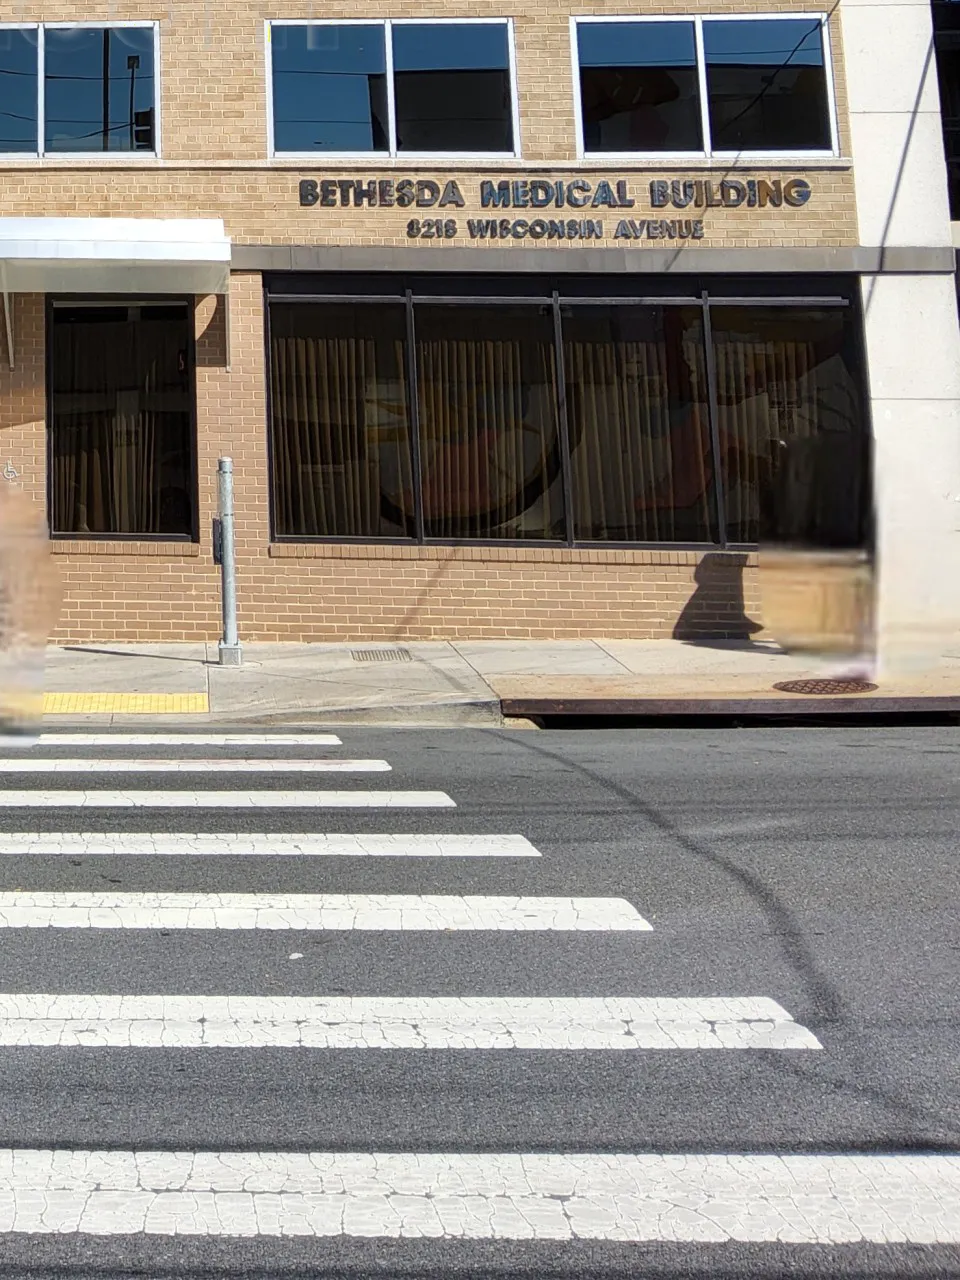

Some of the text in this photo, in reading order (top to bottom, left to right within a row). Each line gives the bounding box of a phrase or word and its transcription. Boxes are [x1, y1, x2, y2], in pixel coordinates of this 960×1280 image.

[299, 179, 811, 208] BETHESDA MEDICAL BUILDING
[467, 219, 603, 239] WISCONSIN
[614, 219, 705, 240] AVENUE
